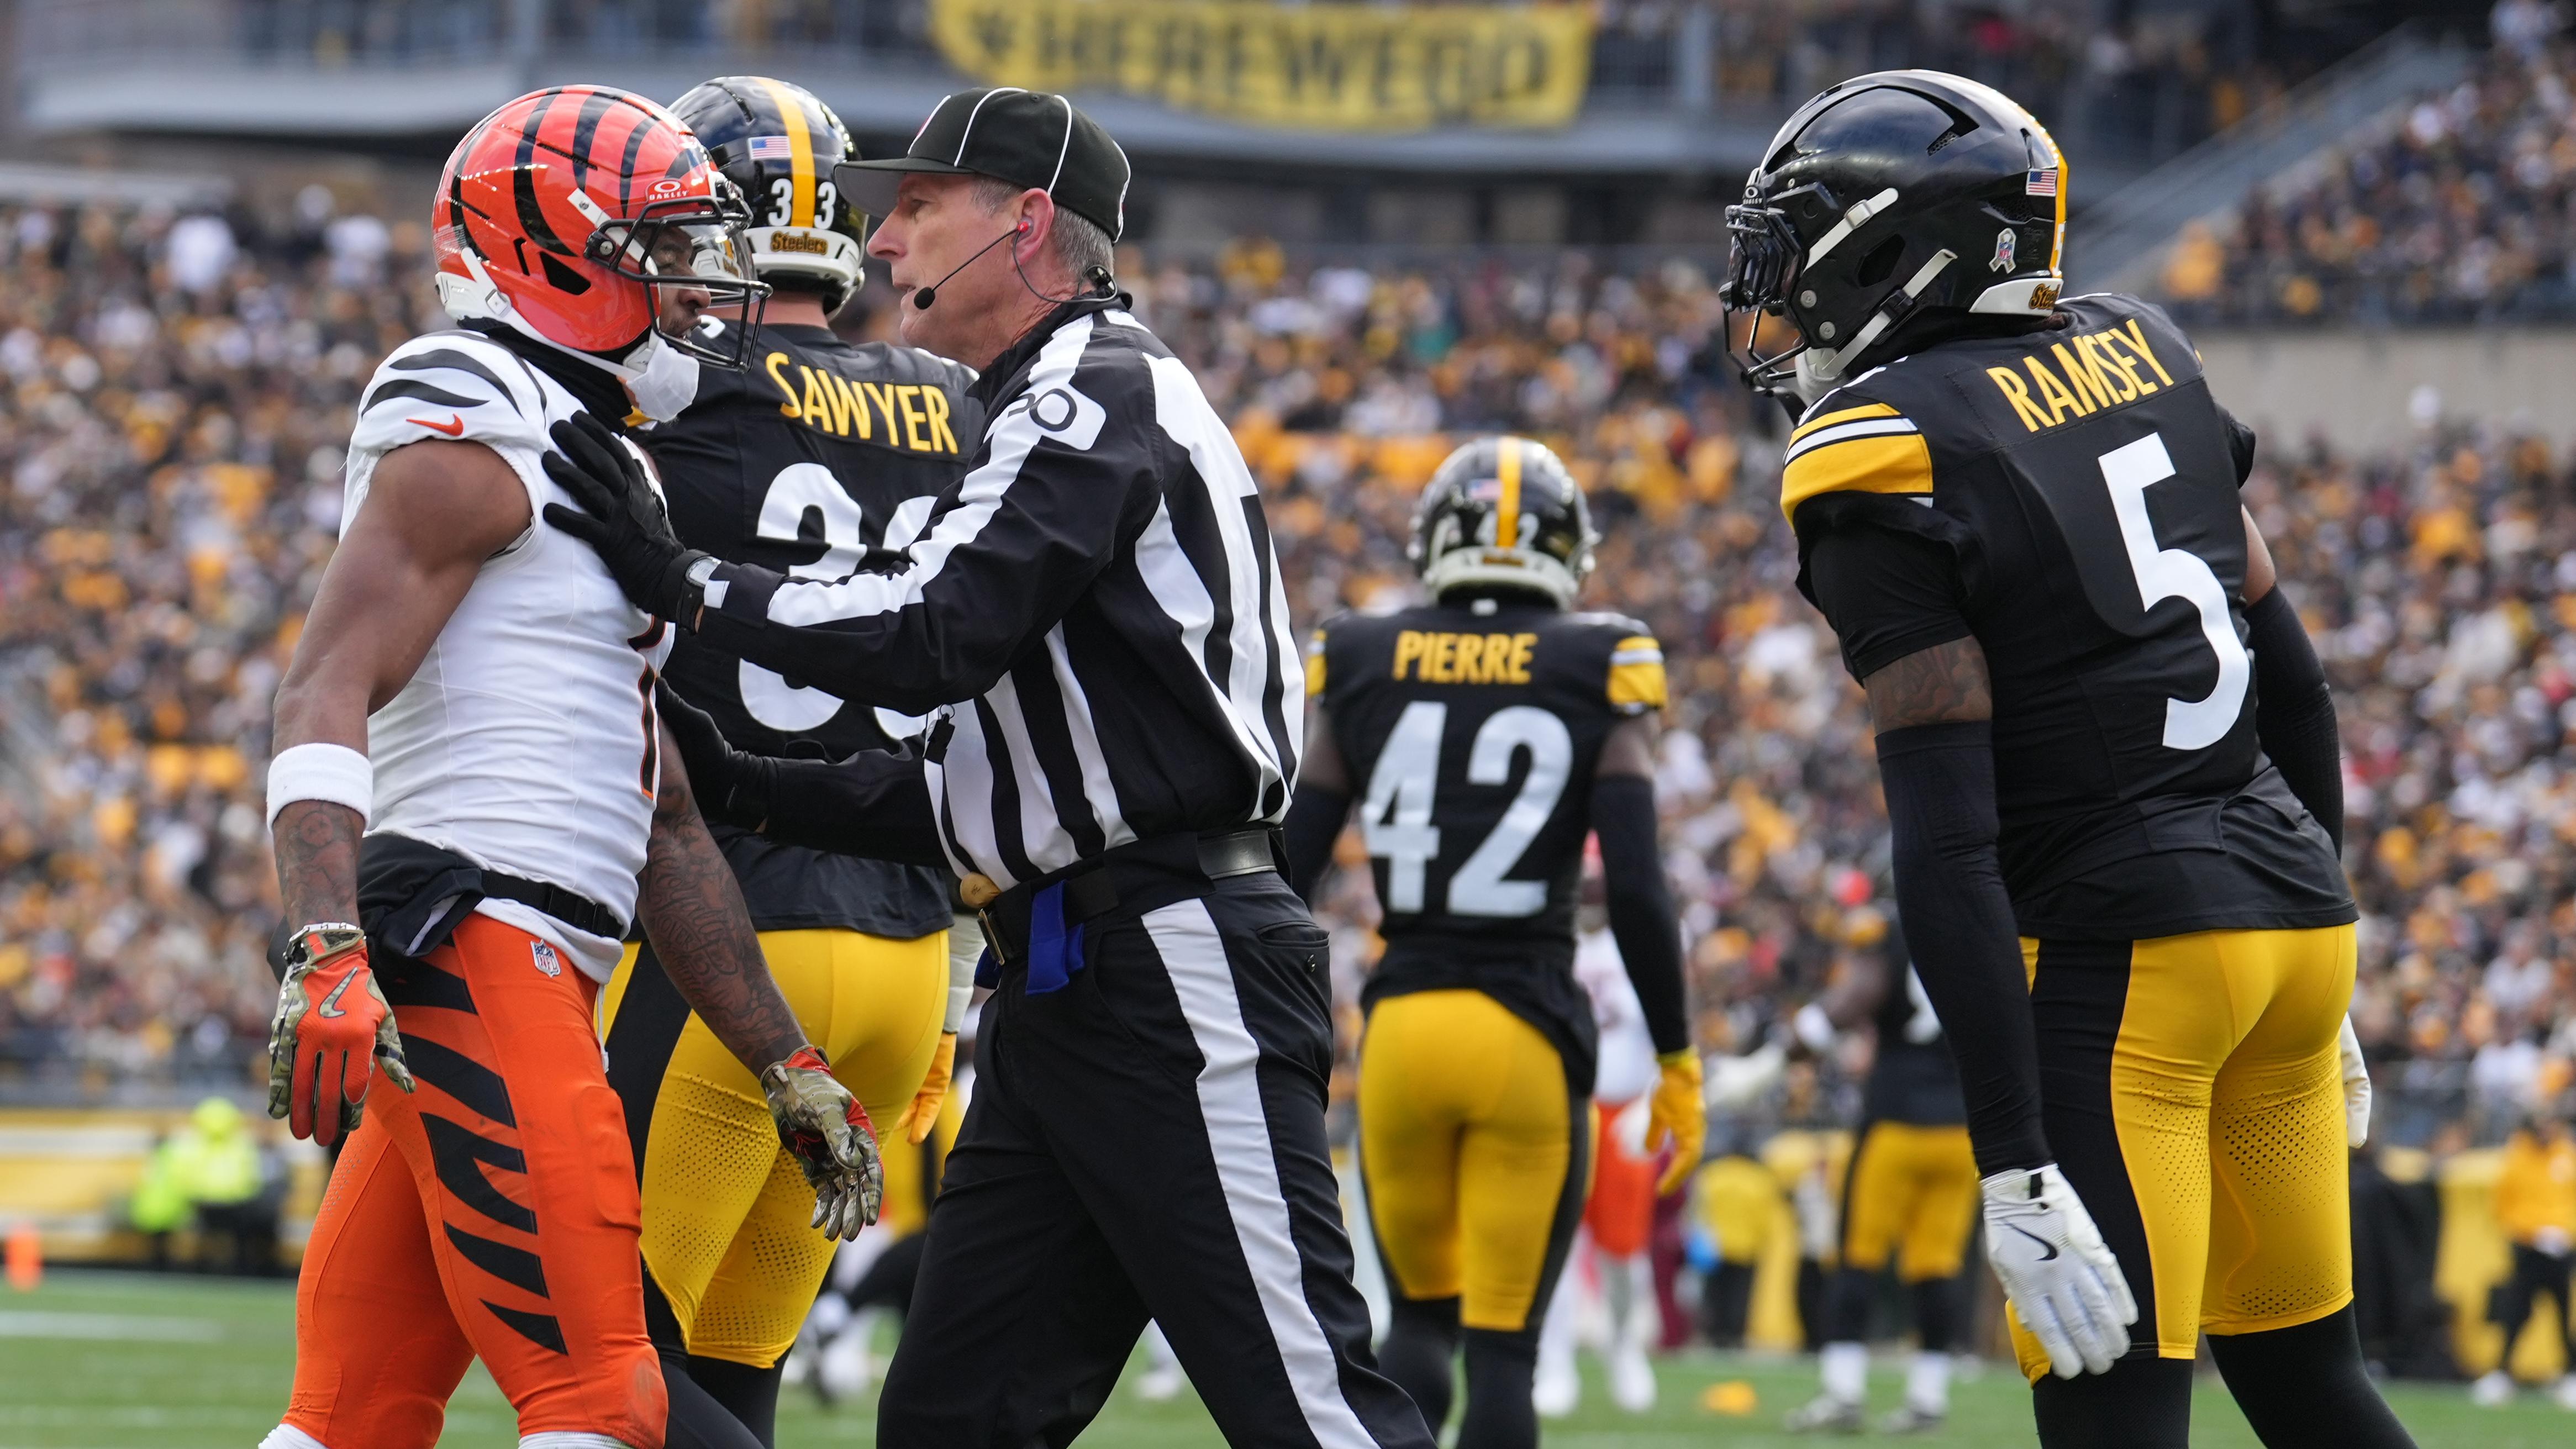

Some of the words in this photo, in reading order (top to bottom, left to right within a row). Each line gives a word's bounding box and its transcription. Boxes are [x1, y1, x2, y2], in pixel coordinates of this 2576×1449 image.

[649, 190, 689, 201] OAKLEY
[771, 231, 828, 255] Steelers
[766, 352, 958, 454] SAWYER
[1987, 319, 2173, 432] RAMSEY
[2098, 431, 2250, 750] 5
[1392, 630, 1537, 684] PIERRE
[1360, 701, 1574, 918] 42
